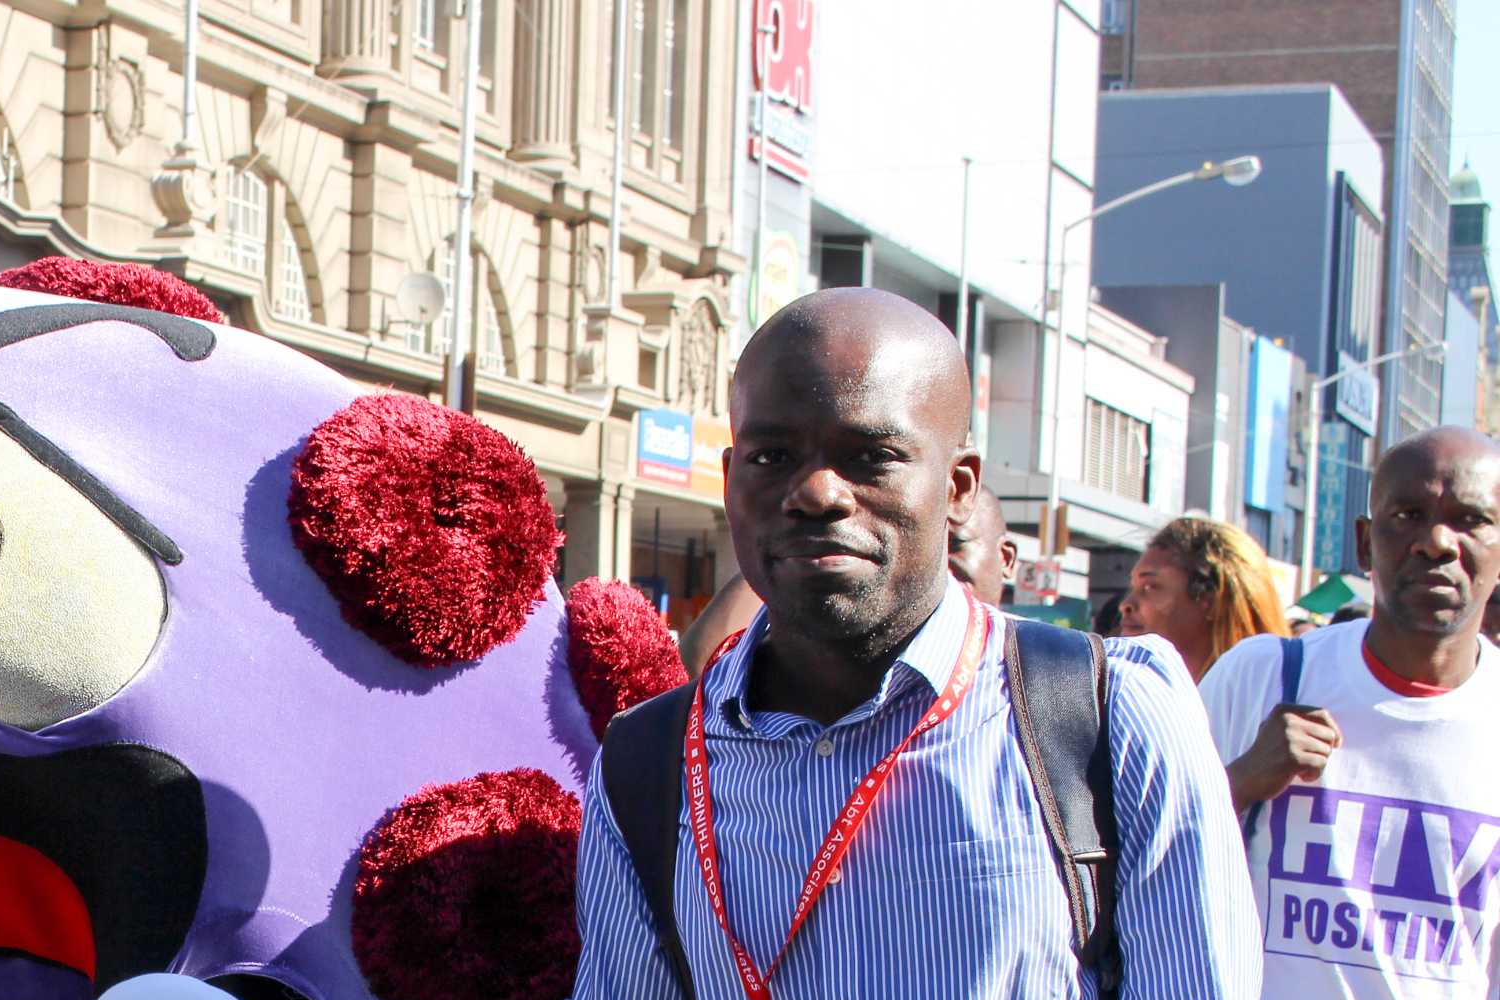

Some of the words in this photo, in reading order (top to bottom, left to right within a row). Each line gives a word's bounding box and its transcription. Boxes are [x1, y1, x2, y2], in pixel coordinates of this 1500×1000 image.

[690, 709, 699, 739] Abt
[690, 763, 710, 855] THINKERS
[840, 793, 865, 827] Abt
[794, 828, 845, 921] Associates
[1282, 795, 1500, 898] HIV
[703, 857, 721, 909] BOLD
